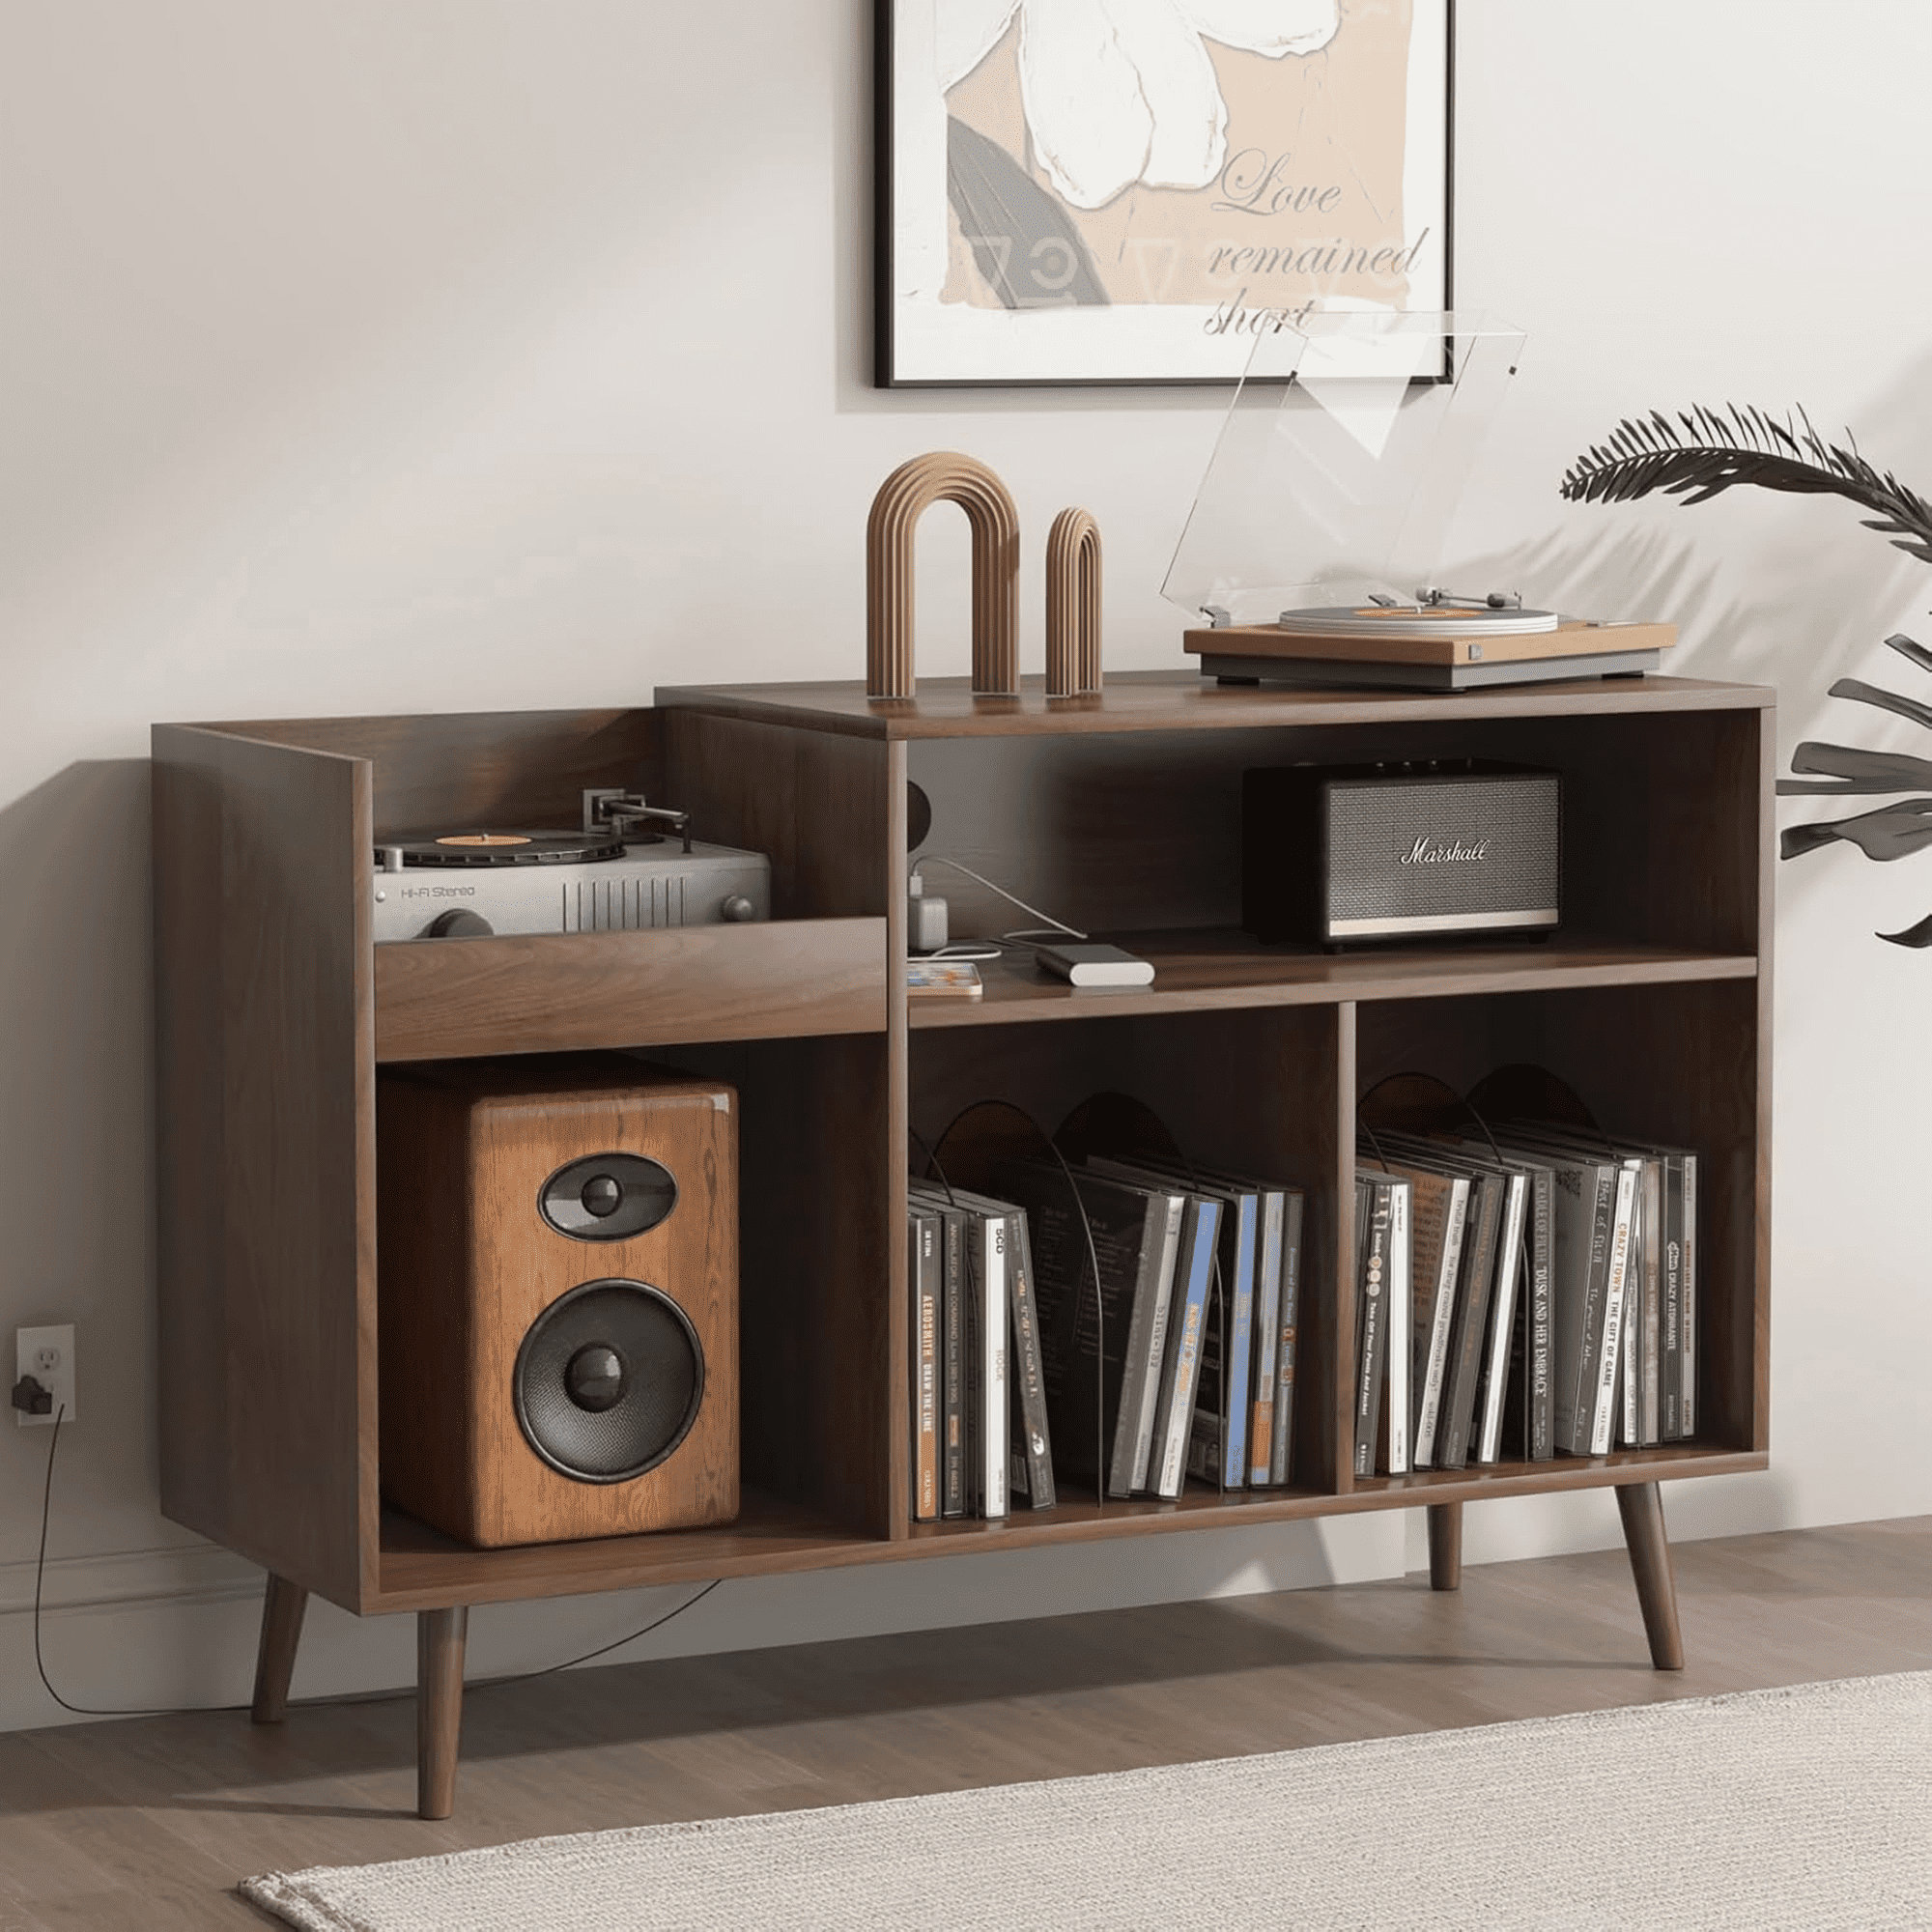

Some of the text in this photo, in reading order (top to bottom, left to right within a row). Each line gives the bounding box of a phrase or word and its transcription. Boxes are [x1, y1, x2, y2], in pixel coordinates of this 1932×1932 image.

[1210, 148, 1342, 216] Love
[1208, 227, 1430, 274] remained
[1204, 287, 1316, 335] short
[1400, 837, 1491, 865] Marshall
[1535, 1179, 1547, 1217] CRADLE
[1535, 1219, 1547, 1234] OF
[1616, 1223, 1628, 1257] CRAZY
[995, 1228, 1005, 1255] 5CD
[1535, 1235, 1547, 1262] FILTH
[1612, 1258, 1624, 1293] TOWN
[1535, 1299, 1548, 1321] AND
[1610, 1300, 1619, 1317] THE
[1535, 1324, 1548, 1345] HER
[1607, 1321, 1617, 1342] GIFT
[923, 1295, 933, 1433] AEROSMITH DRAW THE LINE
[1605, 1346, 1615, 1360] OF
[1603, 1361, 1614, 1387] GAME
